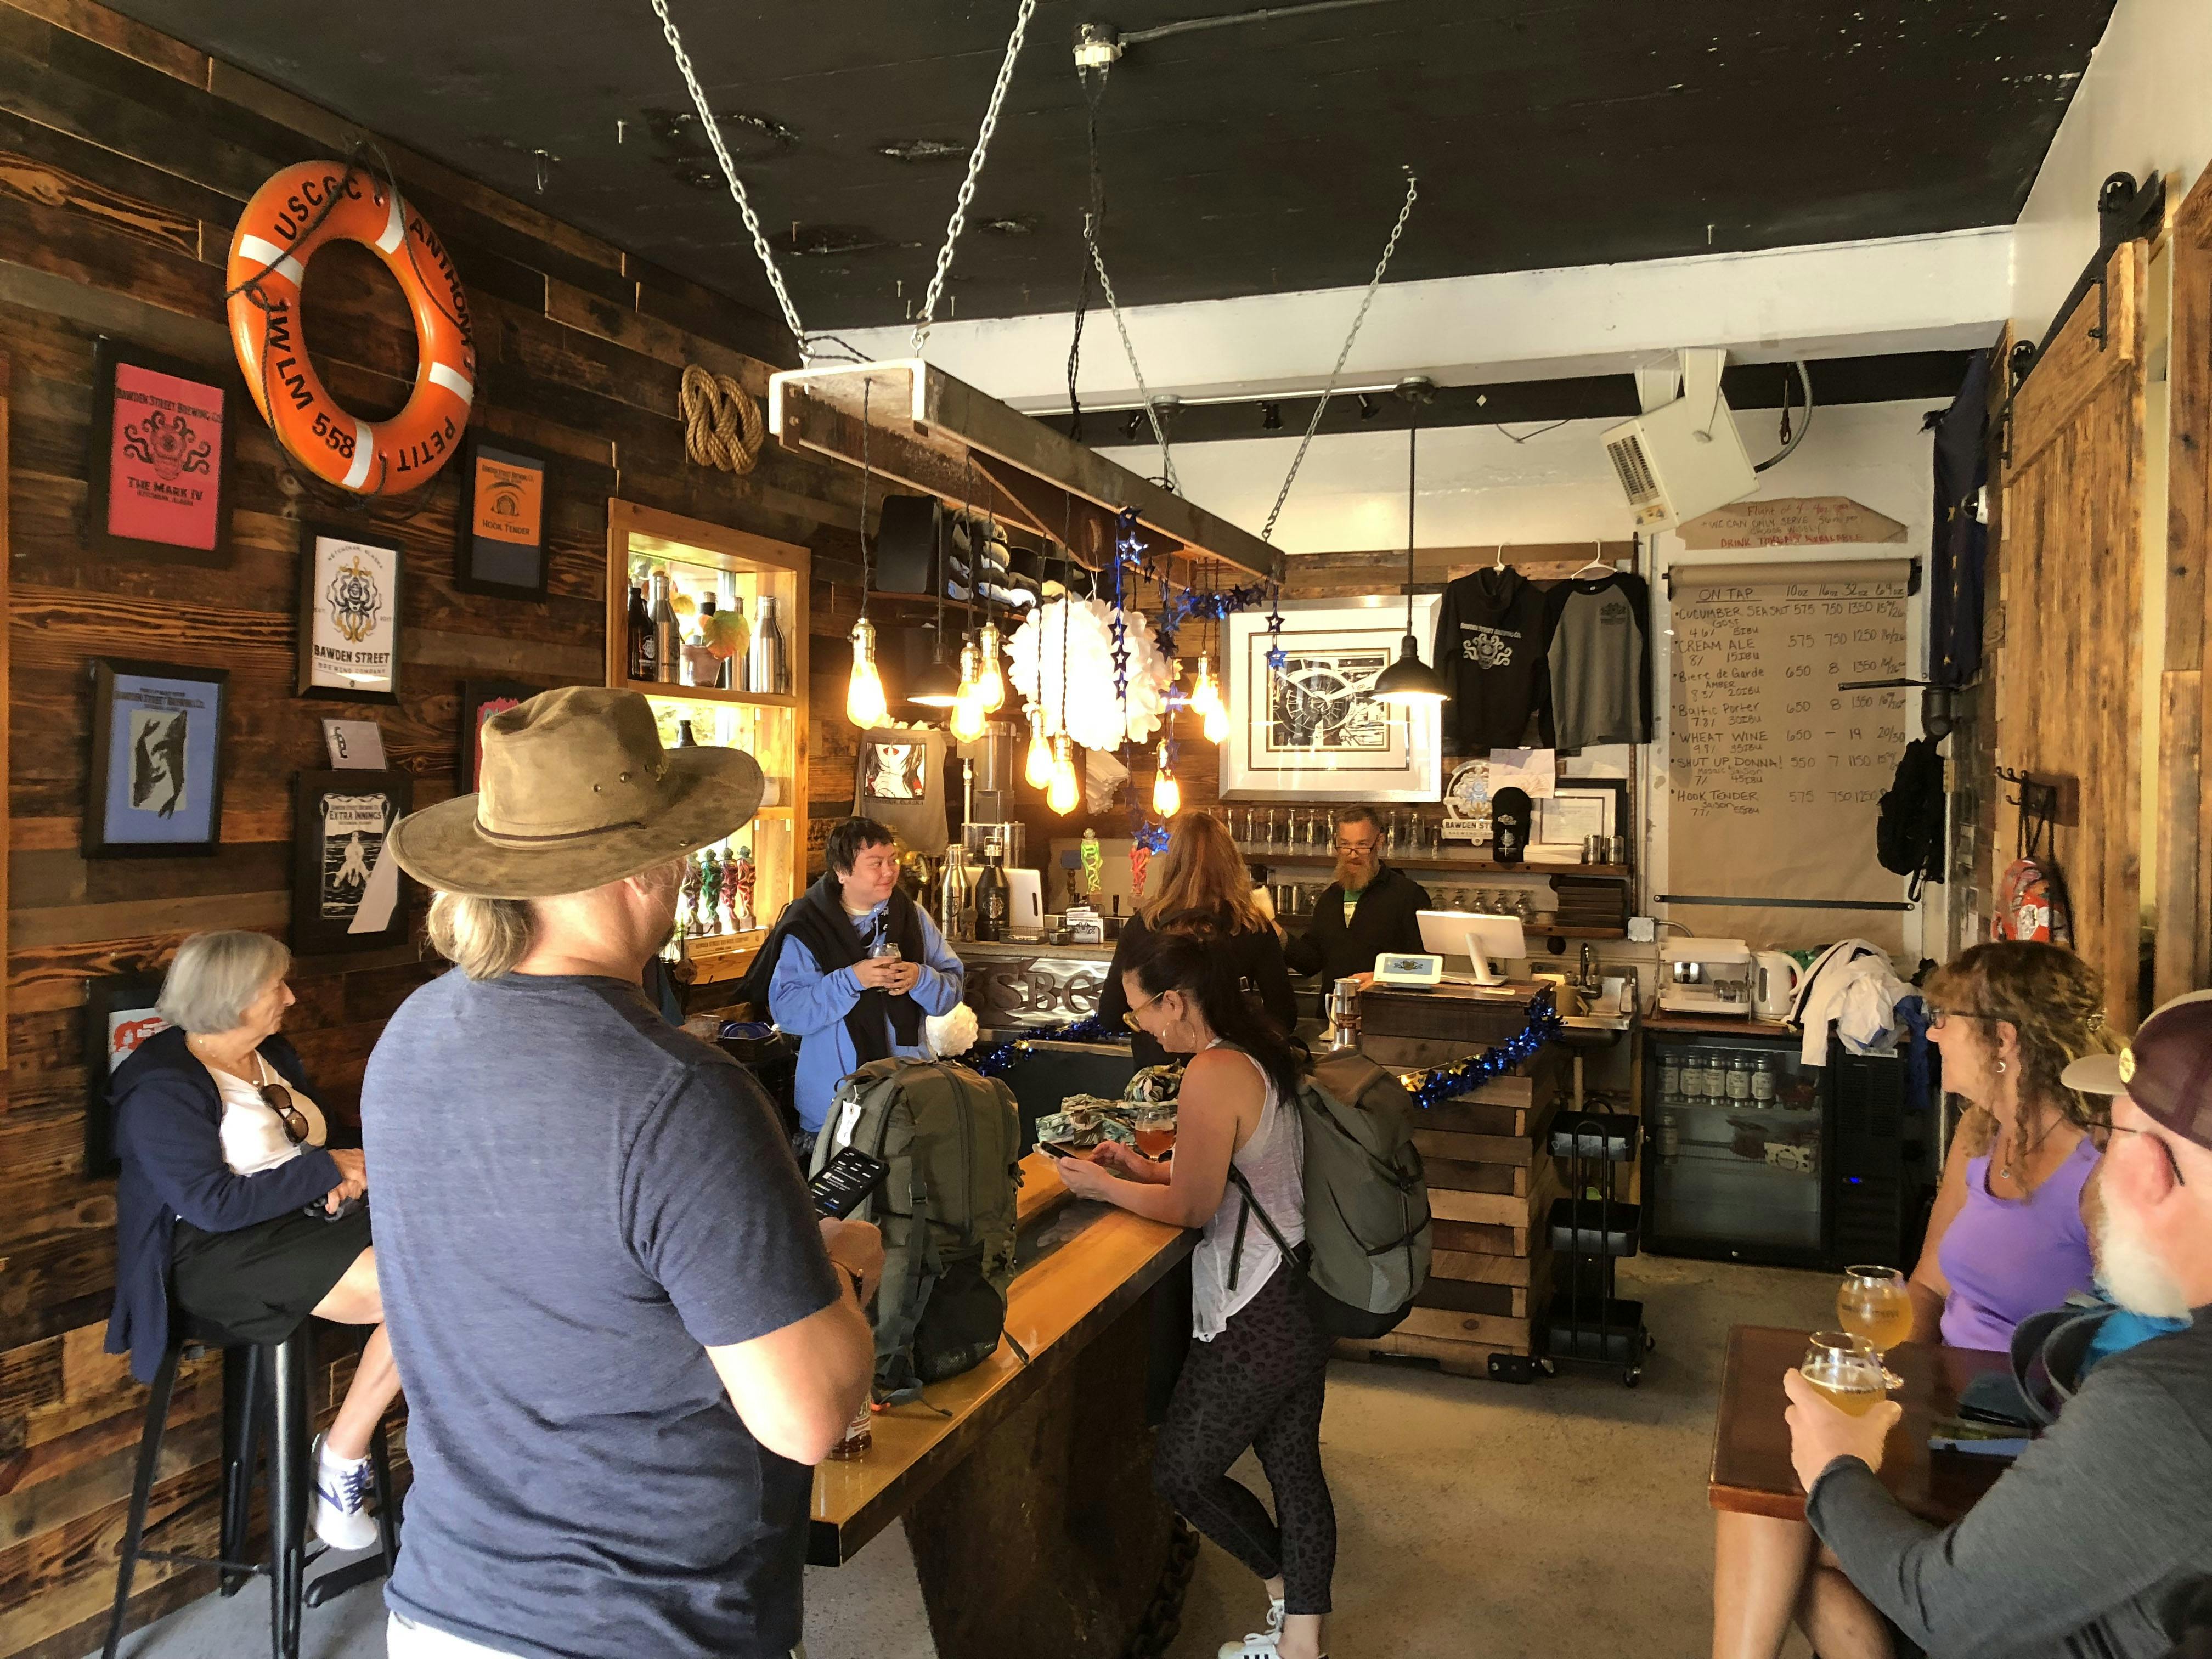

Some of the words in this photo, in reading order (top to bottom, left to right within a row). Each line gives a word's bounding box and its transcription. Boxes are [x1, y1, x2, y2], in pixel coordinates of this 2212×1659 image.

[312, 412, 356, 459] 558
[397, 415, 456, 472] PETIT
[127, 476, 150, 490] THE
[154, 481, 188, 498] MARK
[191, 489, 204, 501] IV
[482, 519, 502, 531] HOOK
[505, 523, 530, 535] TENDER
[1726, 518, 1747, 528] CAN
[1752, 518, 1775, 528] ONLY
[1781, 516, 1808, 526] SERVE
[1720, 538, 1751, 548] DRINK
[1699, 589, 1720, 601] ON
[1726, 588, 1753, 599] TAP
[1786, 584, 1808, 596] 10oz
[1842, 583, 1868, 596] 32oz
[1875, 583, 1904, 595] 64oz
[1679, 607, 1742, 620] CUCUMBER
[1747, 606, 1768, 617] SEA
[1769, 605, 1790, 616] SALT
[1793, 603, 1815, 615] 575
[1822, 603, 1843, 615] 750
[1848, 602, 1873, 614] 1350
[1678, 640, 1722, 653] CREAM
[1729, 639, 1756, 650] ALE
[1787, 634, 1815, 648] 575
[1824, 633, 1847, 646] 750
[314, 645, 352, 663] BAWDEN
[355, 651, 390, 664] STREET
[318, 662, 352, 673] BREWING
[1679, 672, 1711, 683] Biere
[1716, 668, 1728, 678] de
[1731, 667, 1765, 678] Garde
[1785, 664, 1811, 678] 650
[1828, 662, 1839, 674] 8
[1853, 660, 1877, 673] 1350
[1705, 681, 1735, 689] AMBER
[1678, 704, 1718, 717] Baltic
[1722, 702, 1760, 714] Porter
[1786, 701, 1811, 714] 650
[1829, 698, 1841, 711] 8
[1679, 732, 1724, 743] WHEAT
[1731, 731, 1769, 742] WINE
[1786, 729, 1812, 742] 650
[1849, 727, 1861, 740] 19
[1677, 757, 1709, 769] SHUT
[1734, 755, 1783, 769] DONNA!
[1790, 756, 1816, 768] 550
[1827, 755, 1839, 767] 7
[1848, 754, 1872, 767] 1150
[1677, 789, 1707, 802] HOOK
[1710, 789, 1759, 801] TENDER
[1788, 790, 1814, 803] 575
[1827, 791, 1852, 803] 750
[330, 810, 352, 820] EXTRA
[355, 810, 381, 820] INNINGS
[1445, 821, 1476, 830] BAWDEN
